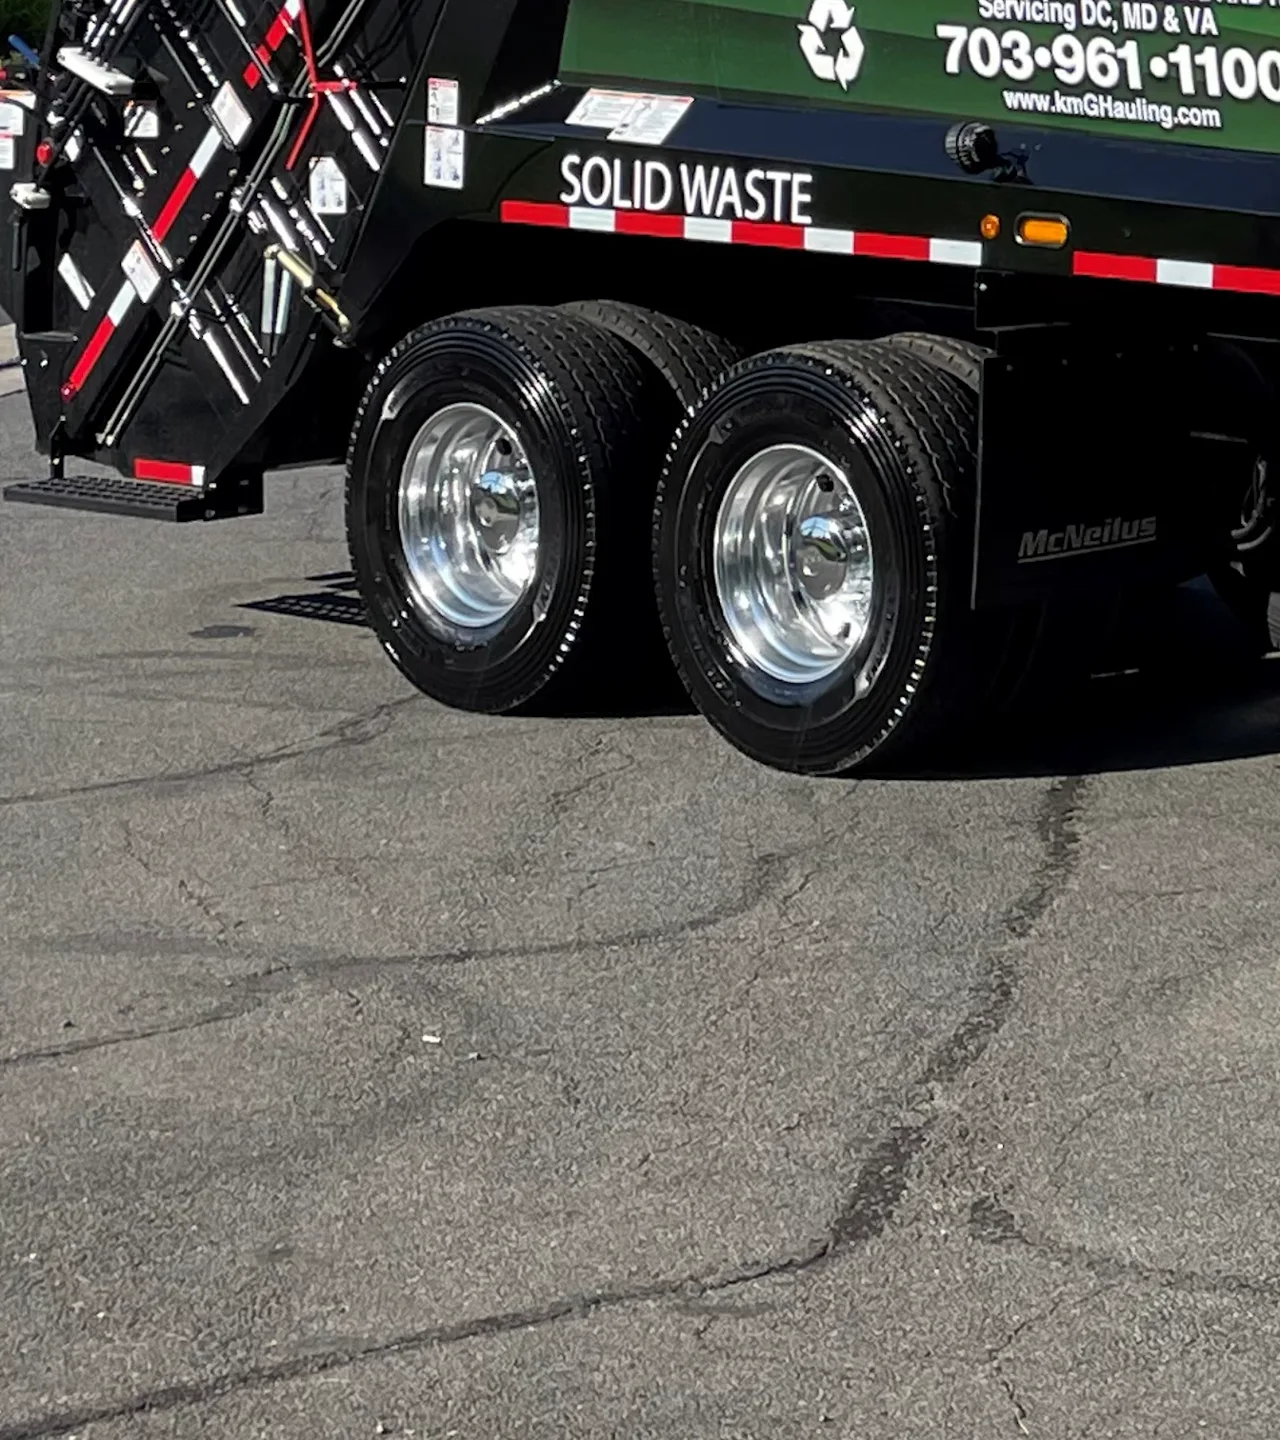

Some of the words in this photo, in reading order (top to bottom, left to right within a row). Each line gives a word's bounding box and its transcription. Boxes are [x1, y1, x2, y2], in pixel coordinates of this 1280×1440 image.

[1123, 2, 1158, 31] MD
[1163, 7, 1180, 33] &
[1184, 7, 1219, 37] VA
[1003, 89, 1222, 130] www.kmGHauling.com
[559, 154, 673, 212] SOLID
[679, 163, 814, 225] WASTE
[1017, 516, 1157, 558] McNeilus
